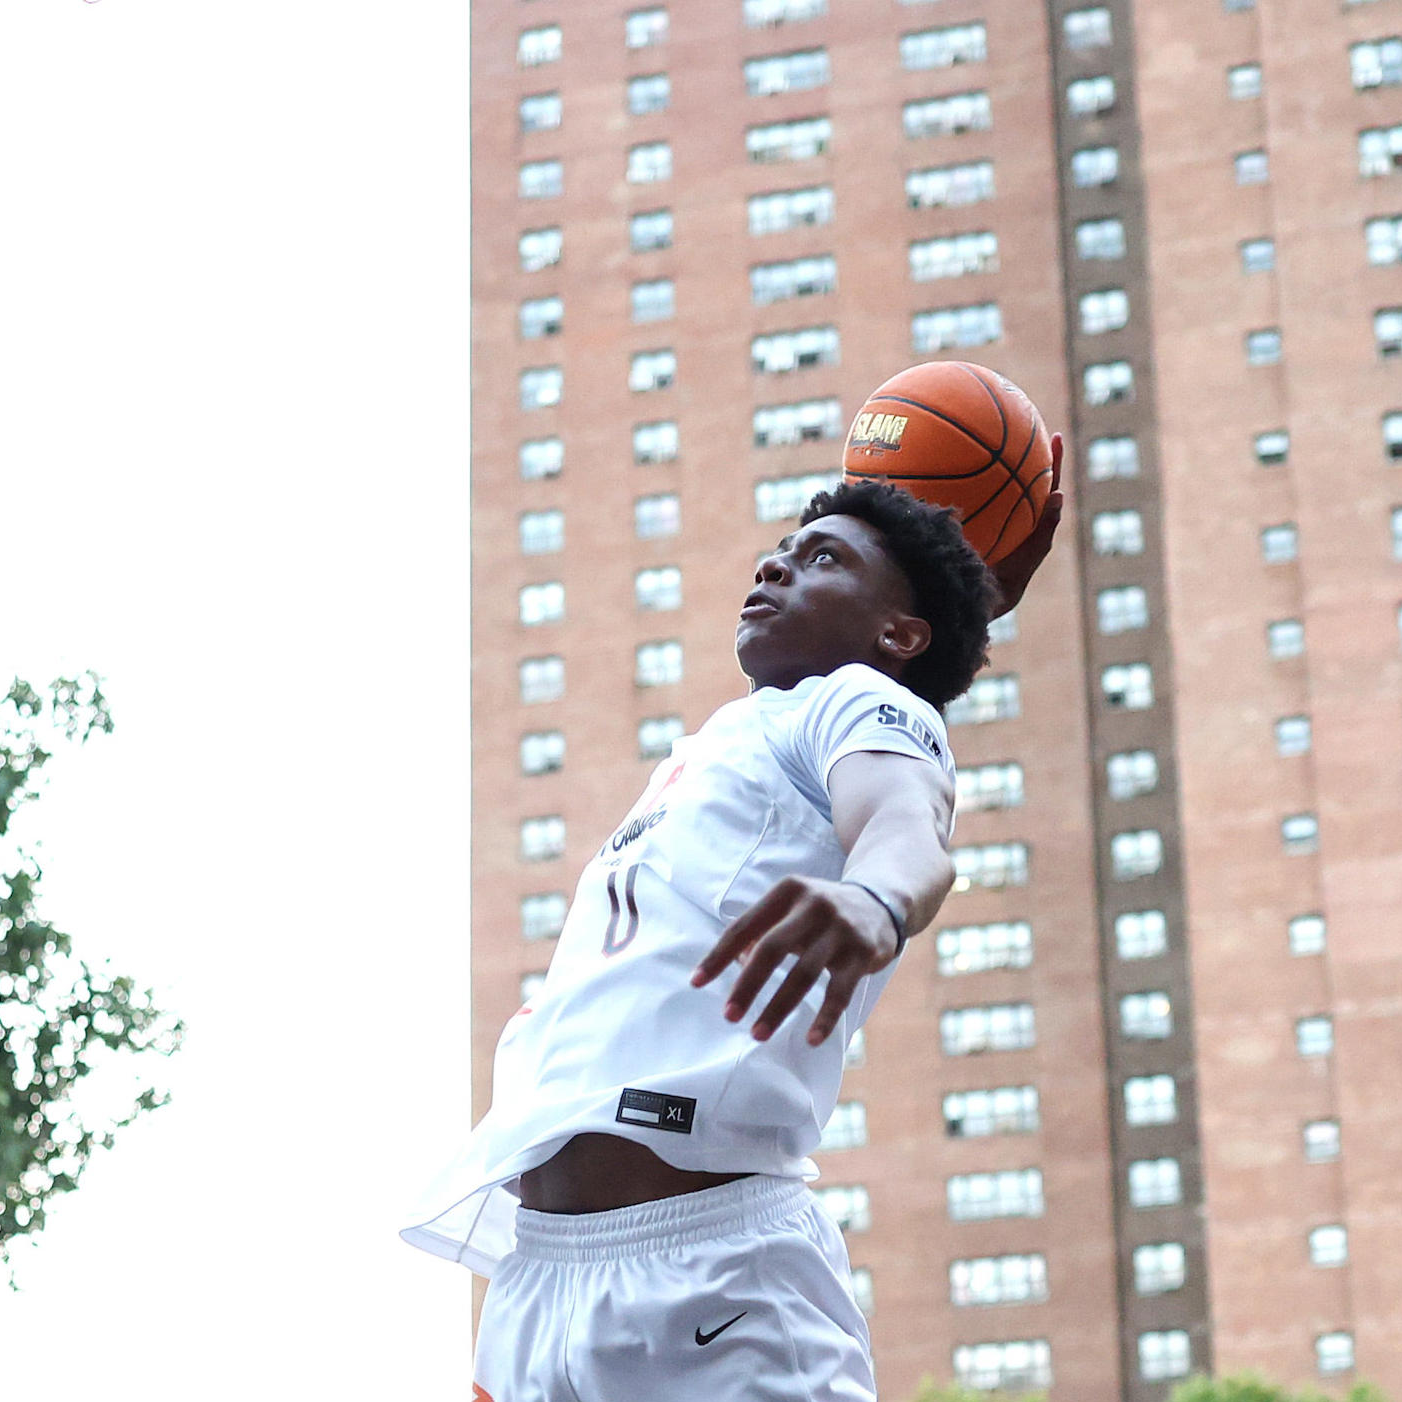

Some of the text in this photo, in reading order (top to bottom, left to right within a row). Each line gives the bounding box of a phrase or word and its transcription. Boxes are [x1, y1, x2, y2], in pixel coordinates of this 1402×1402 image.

[852, 413, 908, 444] SLAM
[878, 704, 942, 757] SLAM
[667, 1106, 684, 1122] XL
